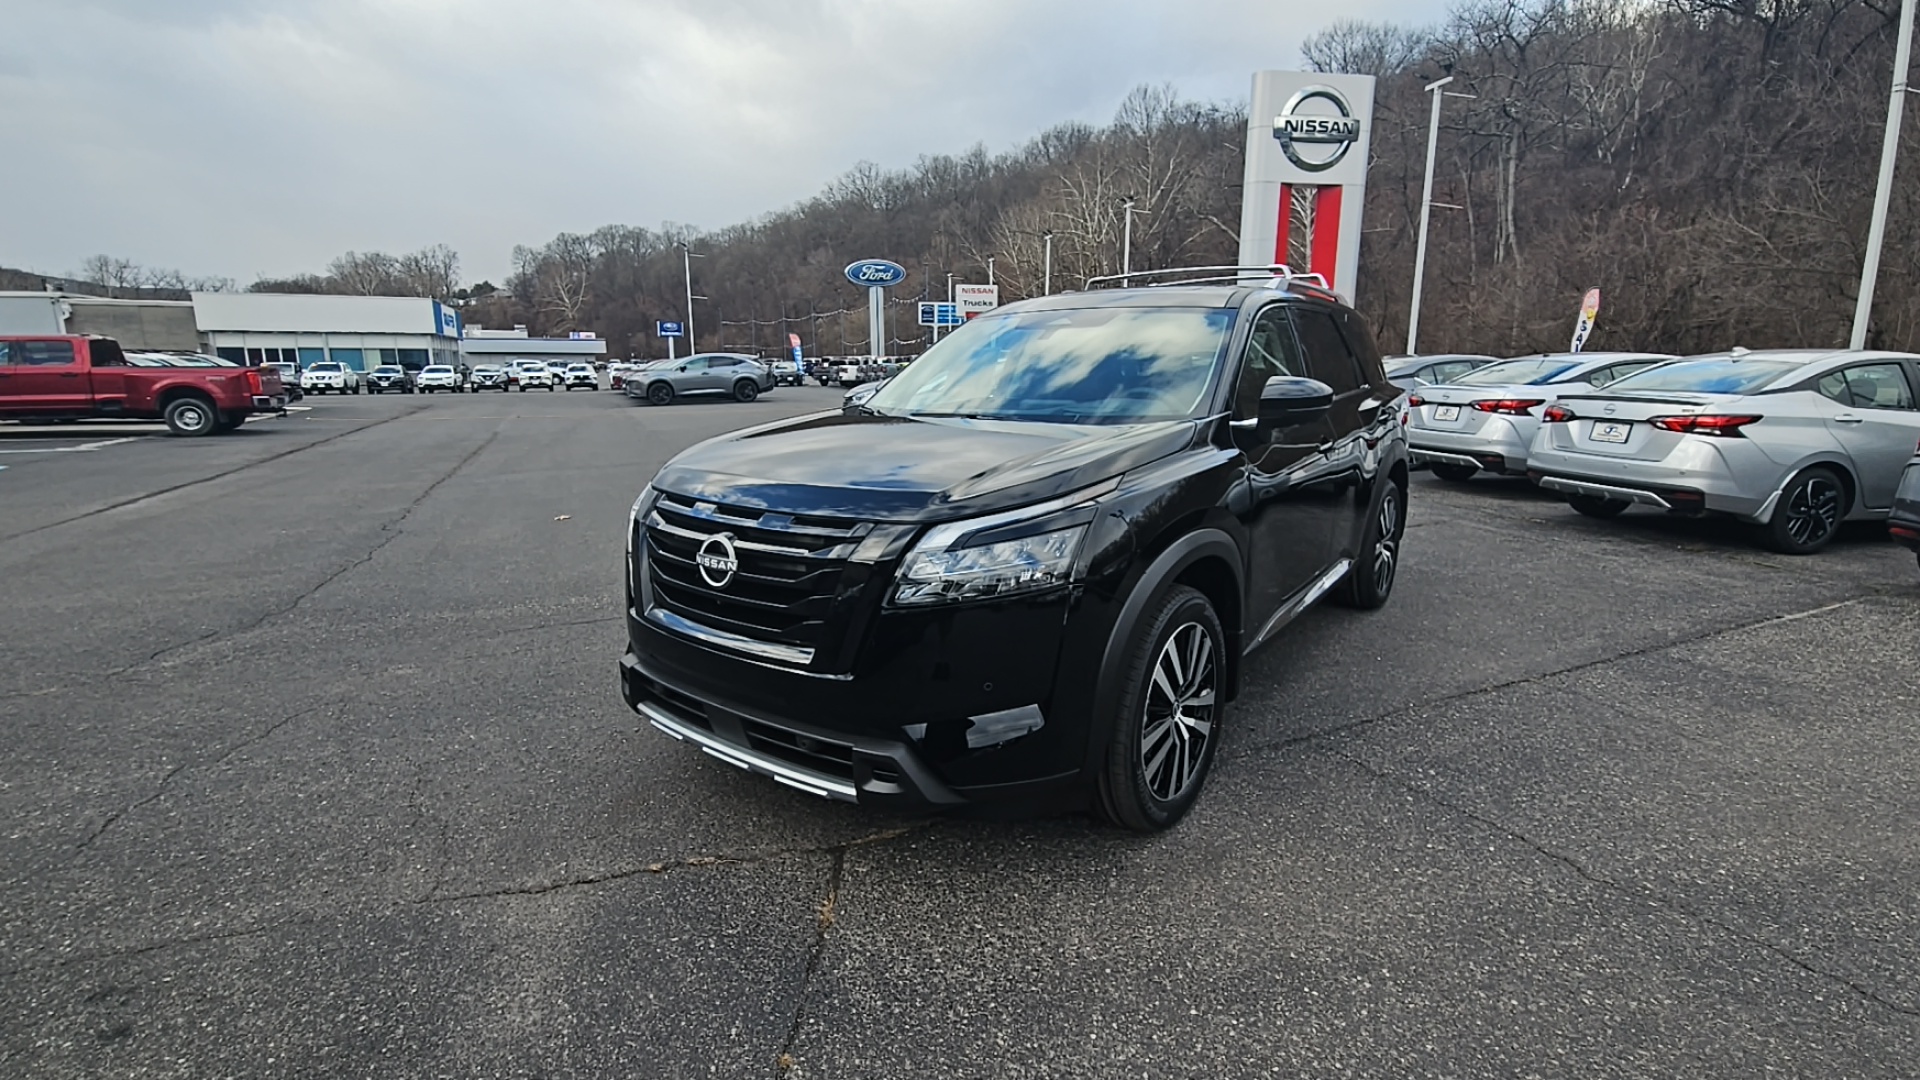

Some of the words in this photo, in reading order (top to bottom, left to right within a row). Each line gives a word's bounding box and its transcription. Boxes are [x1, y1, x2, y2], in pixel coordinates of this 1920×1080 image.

[1284, 119, 1354, 134] NISSAN
[859, 264, 893, 281] Ford
[696, 554, 737, 571] NISSAN
